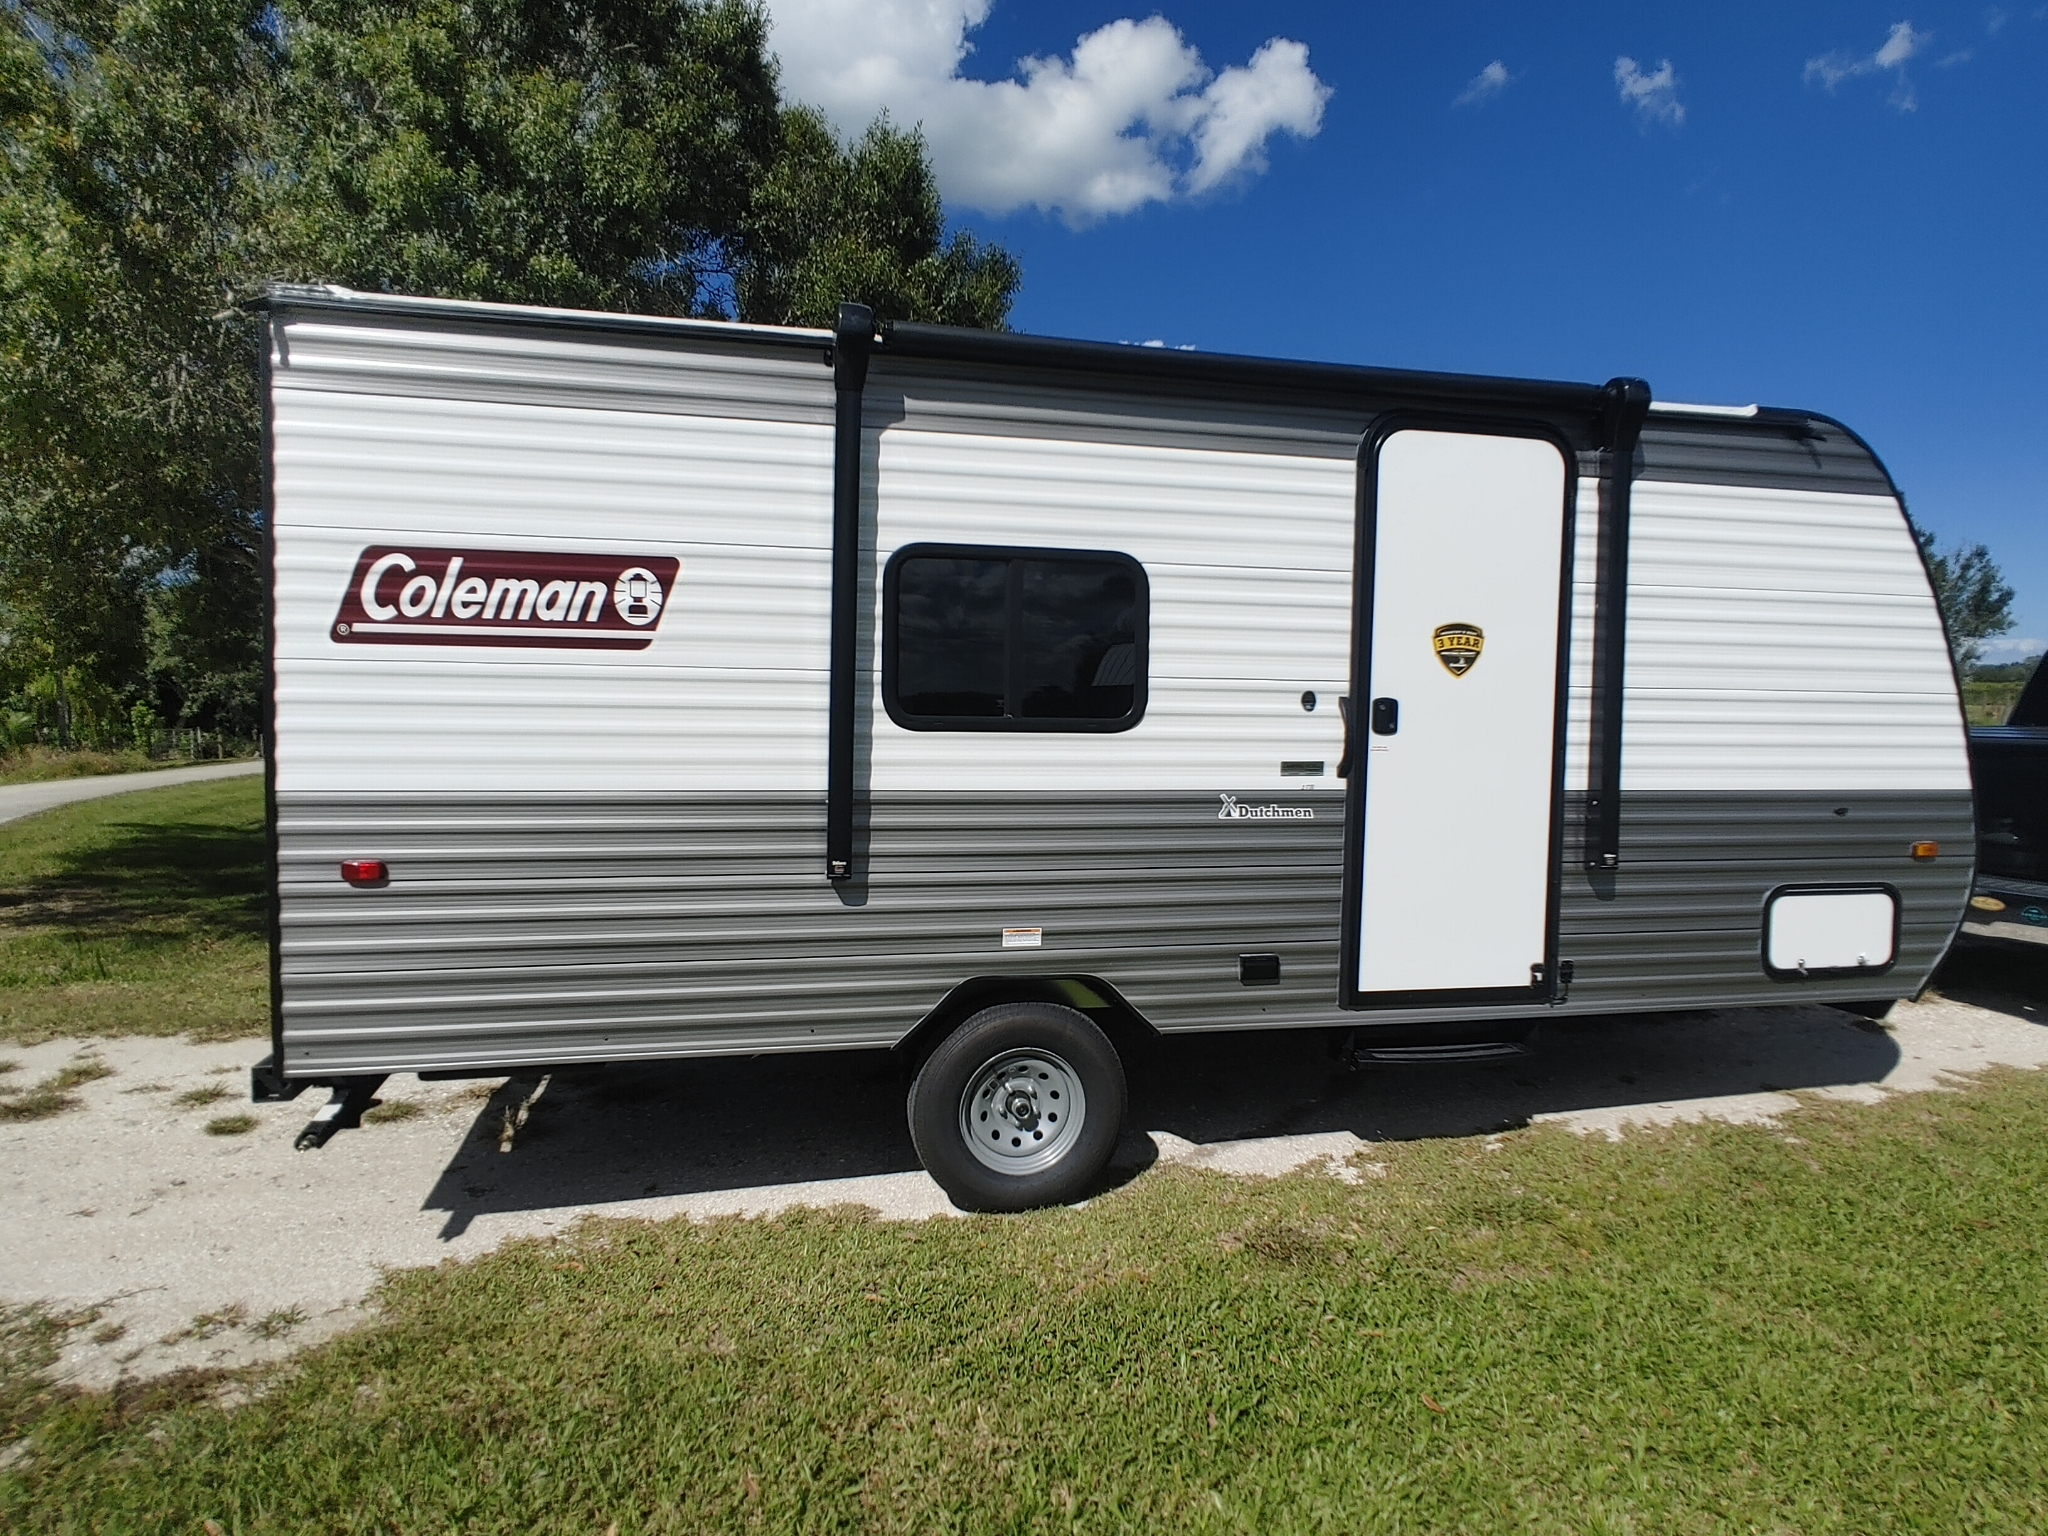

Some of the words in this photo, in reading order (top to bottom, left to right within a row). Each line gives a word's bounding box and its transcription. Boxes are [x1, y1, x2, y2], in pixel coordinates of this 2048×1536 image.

[361, 553, 608, 622] Coleman
[1437, 638, 1445, 649] 3
[1447, 636, 1480, 649] YEAR
[1238, 805, 1312, 818] Dutchmen
